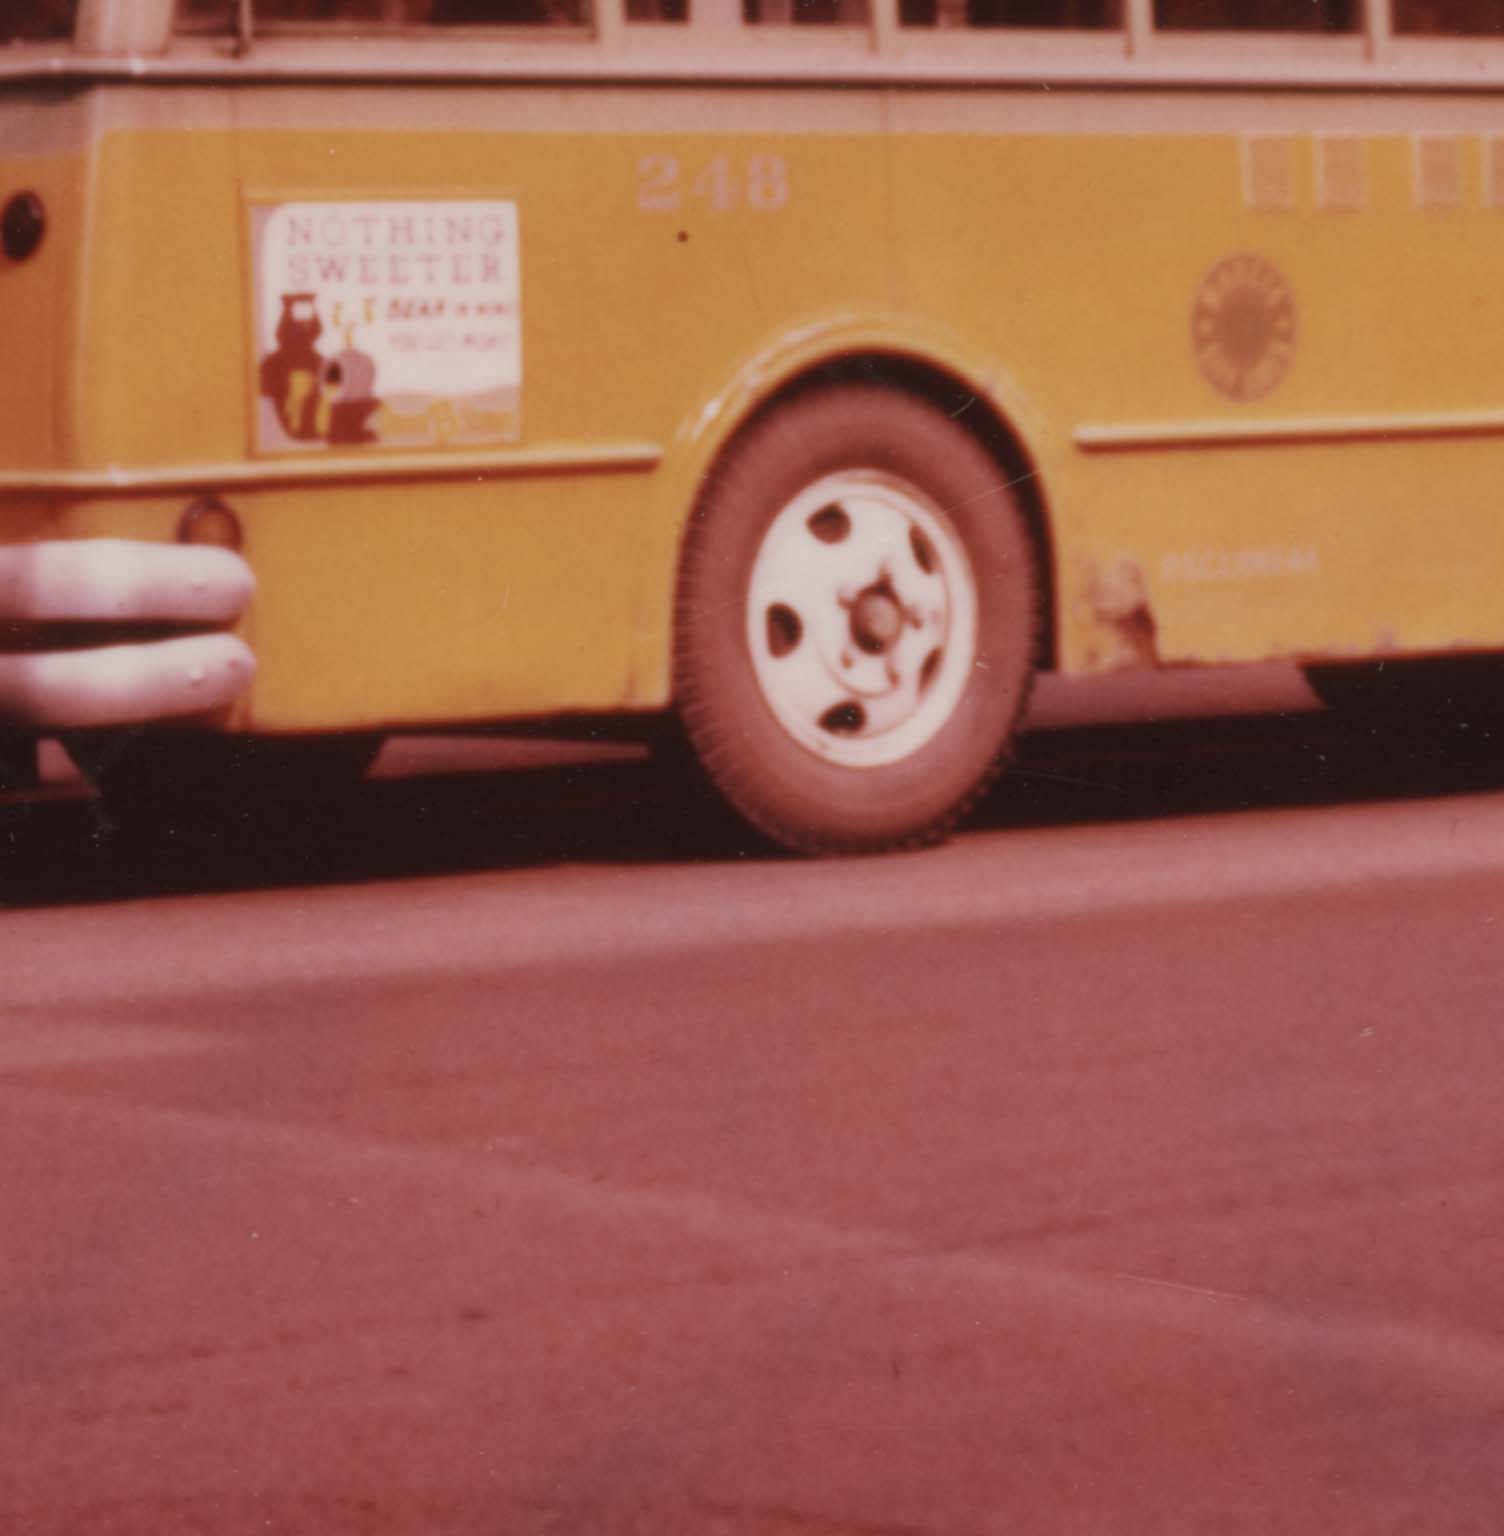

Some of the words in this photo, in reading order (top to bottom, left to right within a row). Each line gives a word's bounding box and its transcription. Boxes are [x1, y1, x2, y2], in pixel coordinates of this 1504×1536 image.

[636, 154, 791, 213] 248
[287, 214, 506, 247] NOTHING
[287, 253, 502, 286] SWEETER
